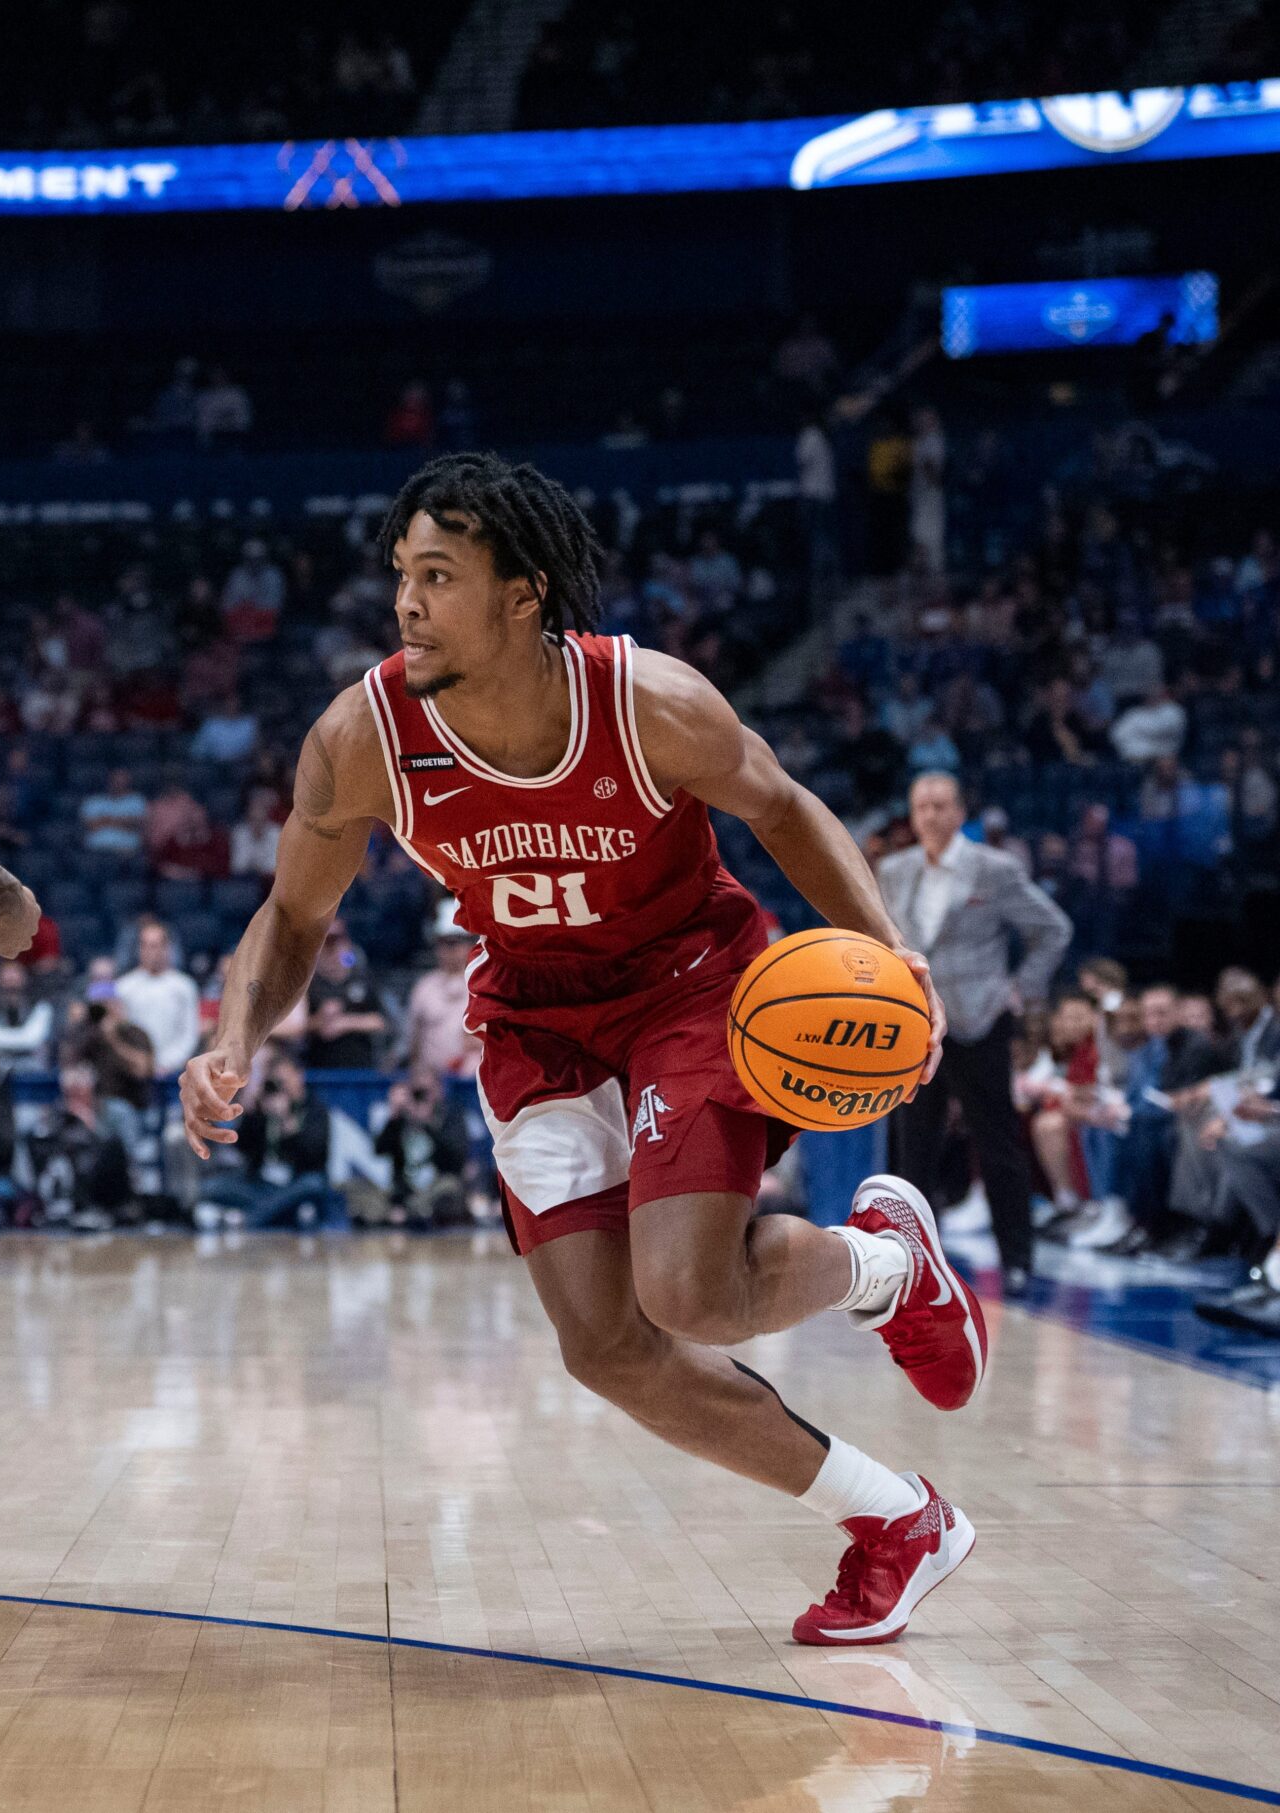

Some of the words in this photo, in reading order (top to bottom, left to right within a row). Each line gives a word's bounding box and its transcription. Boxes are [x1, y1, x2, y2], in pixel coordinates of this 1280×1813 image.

[411, 757, 454, 768] TOGETHER
[594, 776, 618, 799] SEC
[437, 823, 637, 869] RAZORBACKS
[484, 872, 602, 928] 21
[794, 1031, 822, 1044] NXT
[822, 1019, 901, 1051] EVO
[780, 1069, 905, 1117] Wilson
